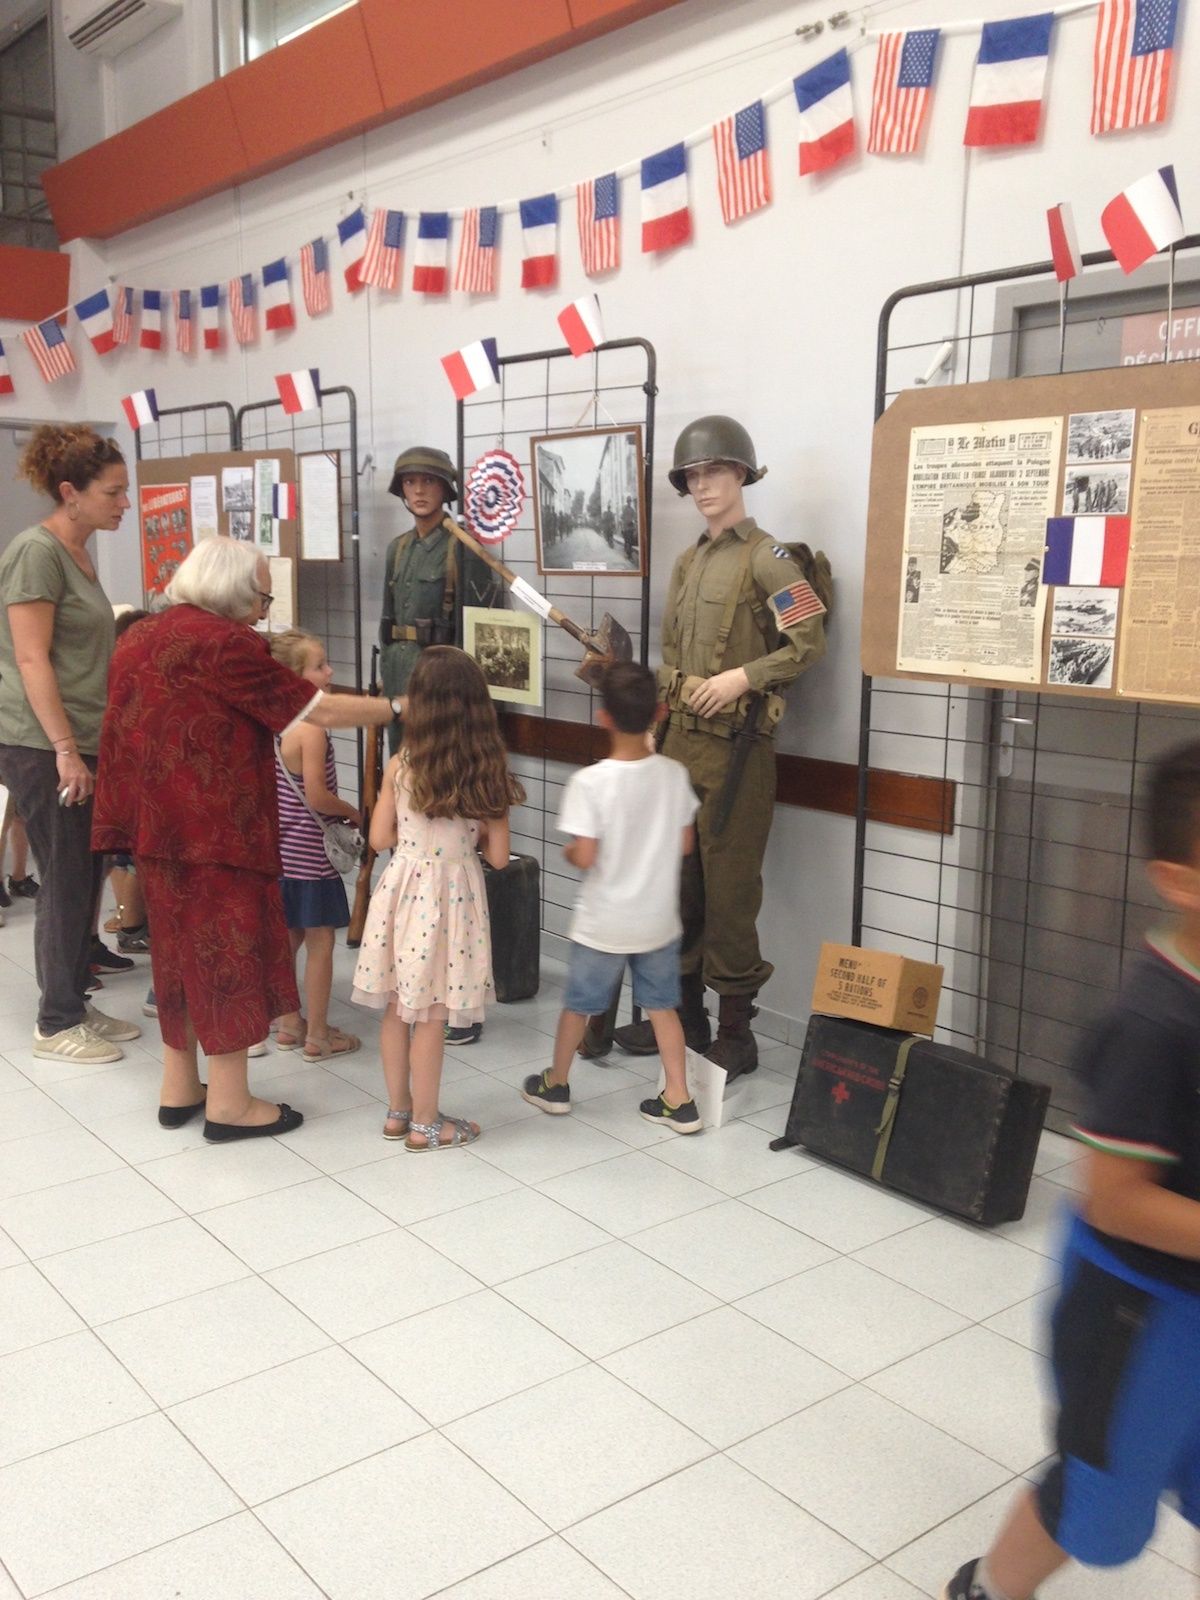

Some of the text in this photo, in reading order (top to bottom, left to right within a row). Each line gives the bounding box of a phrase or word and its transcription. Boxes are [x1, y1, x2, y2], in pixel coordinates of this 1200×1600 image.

[957, 437, 970, 450] Le
[973, 434, 1006, 449] Matin
[839, 958, 858, 970] MENU
[830, 968, 888, 989] SECOND HALF OF
[844, 983, 873, 997] RATIONS
